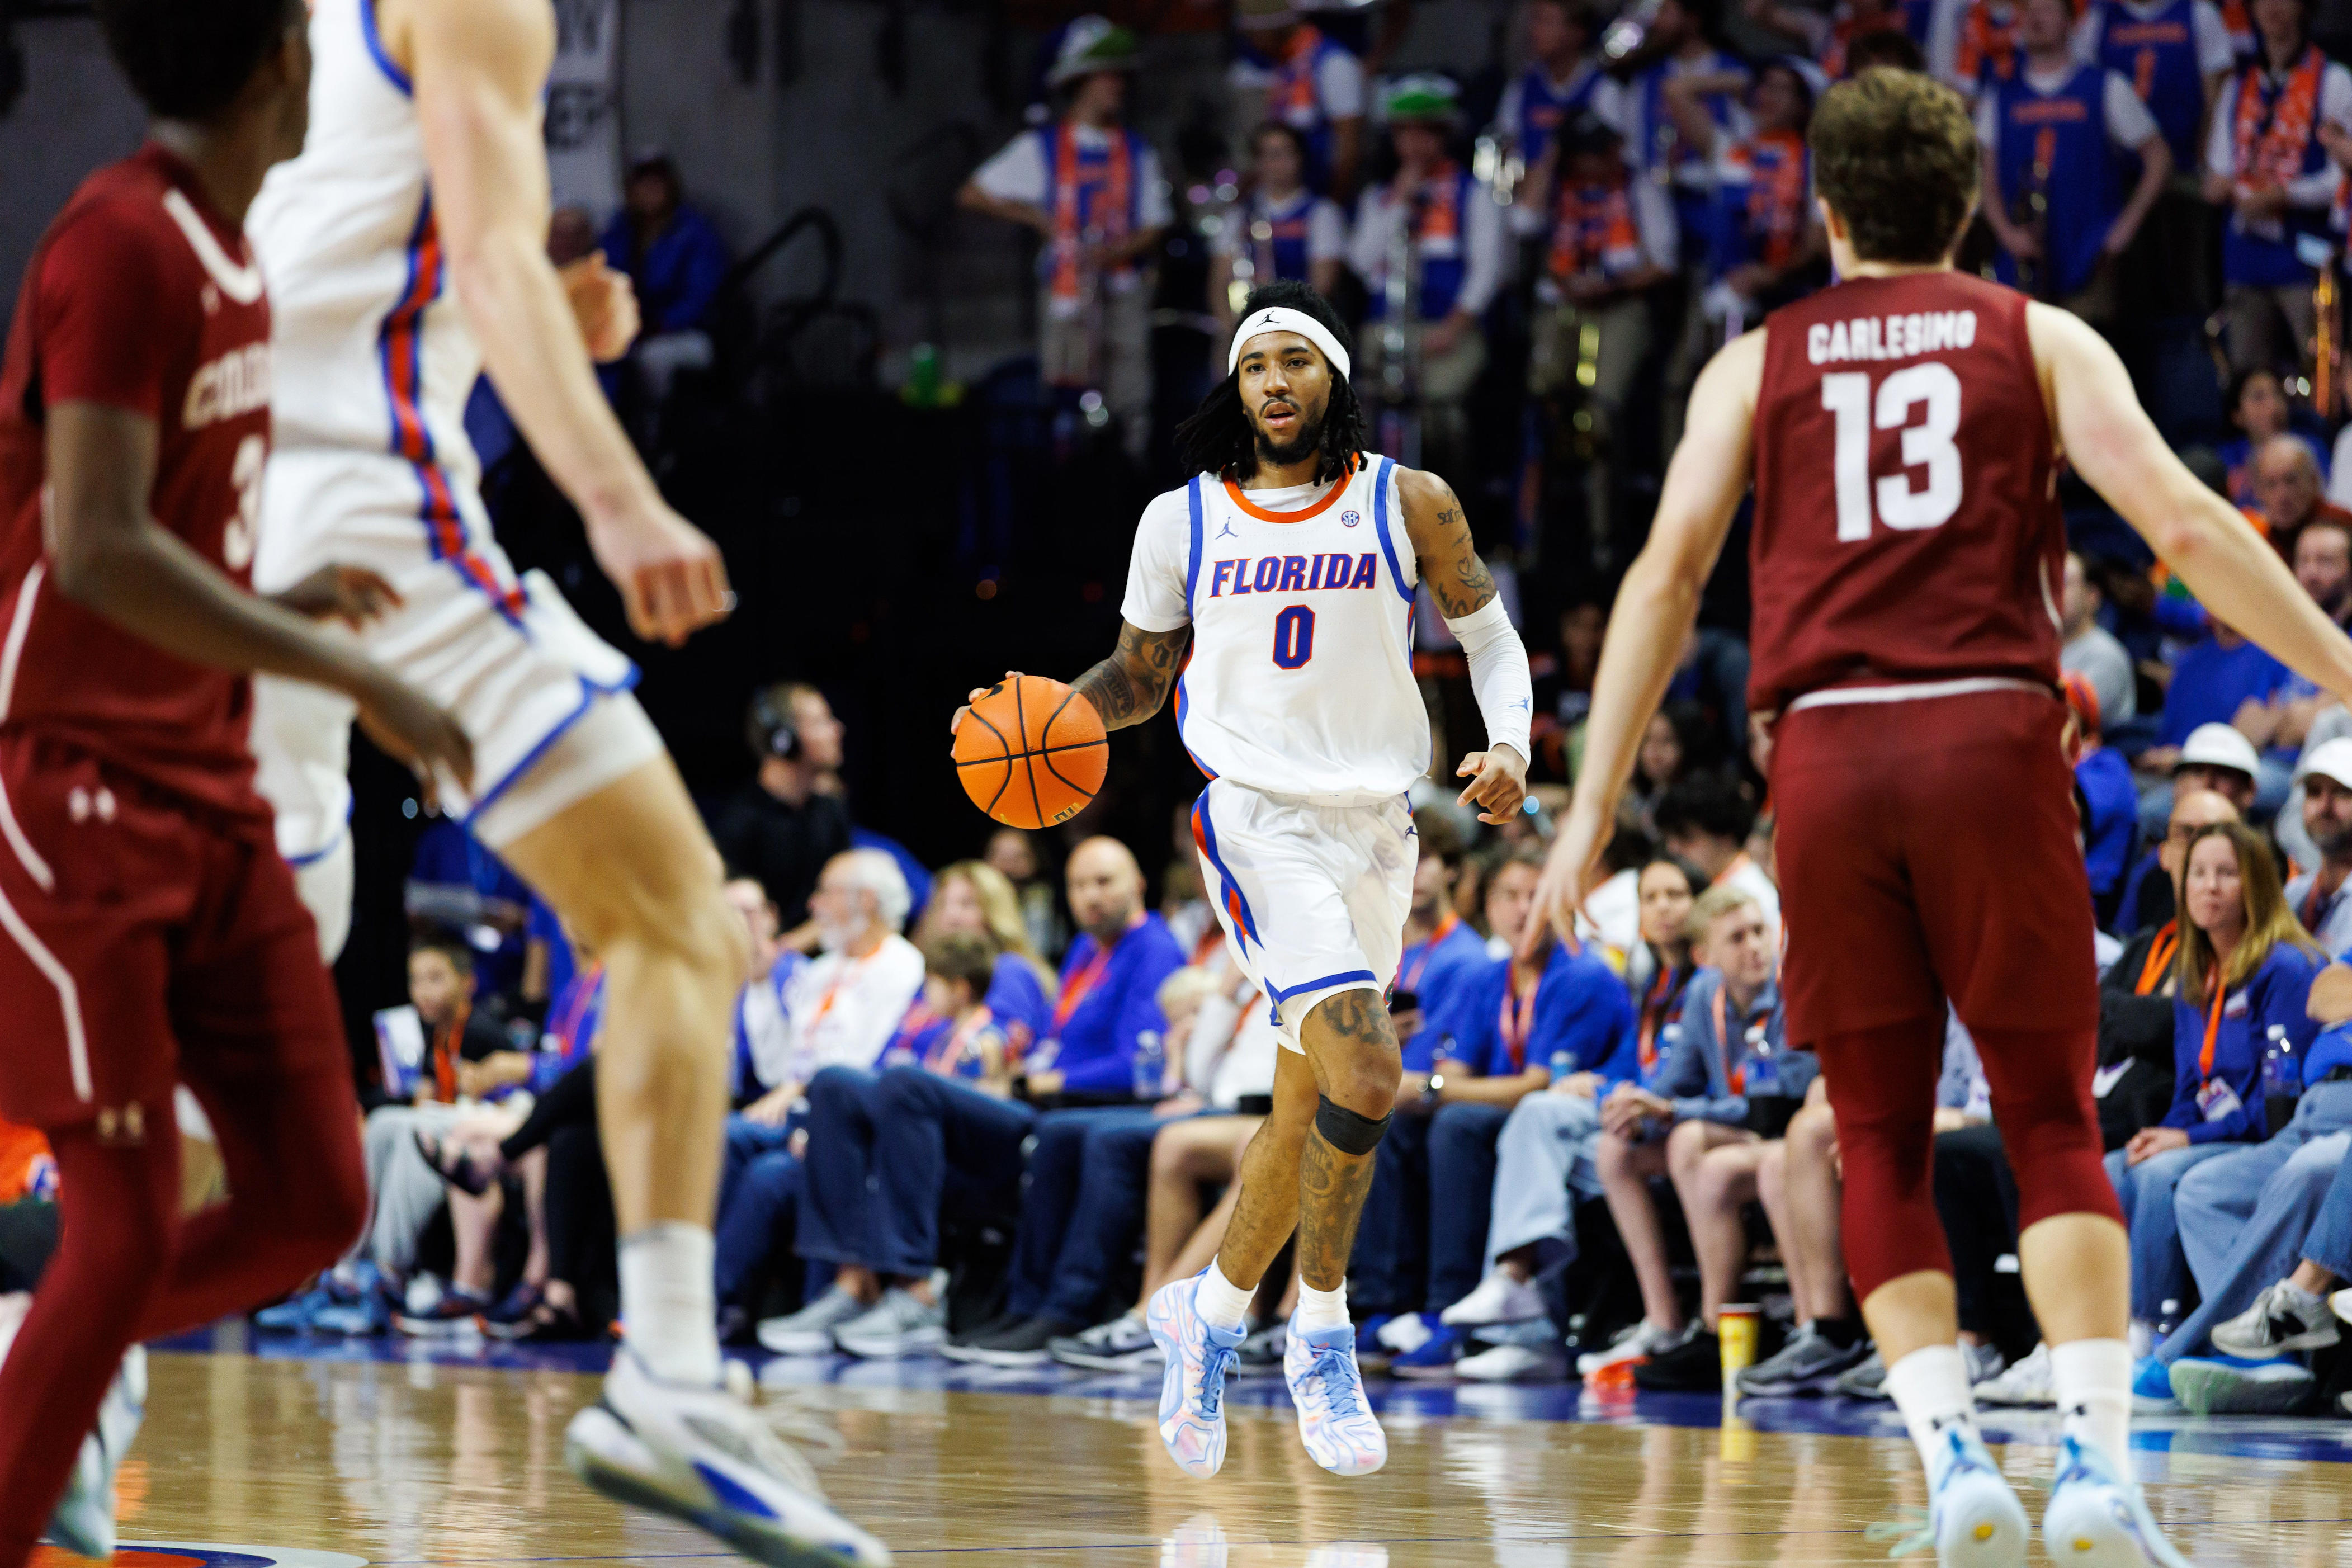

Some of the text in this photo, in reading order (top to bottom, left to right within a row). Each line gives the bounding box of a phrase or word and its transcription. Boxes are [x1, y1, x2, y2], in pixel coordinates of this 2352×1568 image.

[1807, 310, 1978, 365] CARLESIMO
[1821, 361, 1963, 542] 13
[1342, 511, 1359, 526] SEC
[1208, 553, 1377, 598] FLORIDA
[1272, 604, 1316, 670] 0
